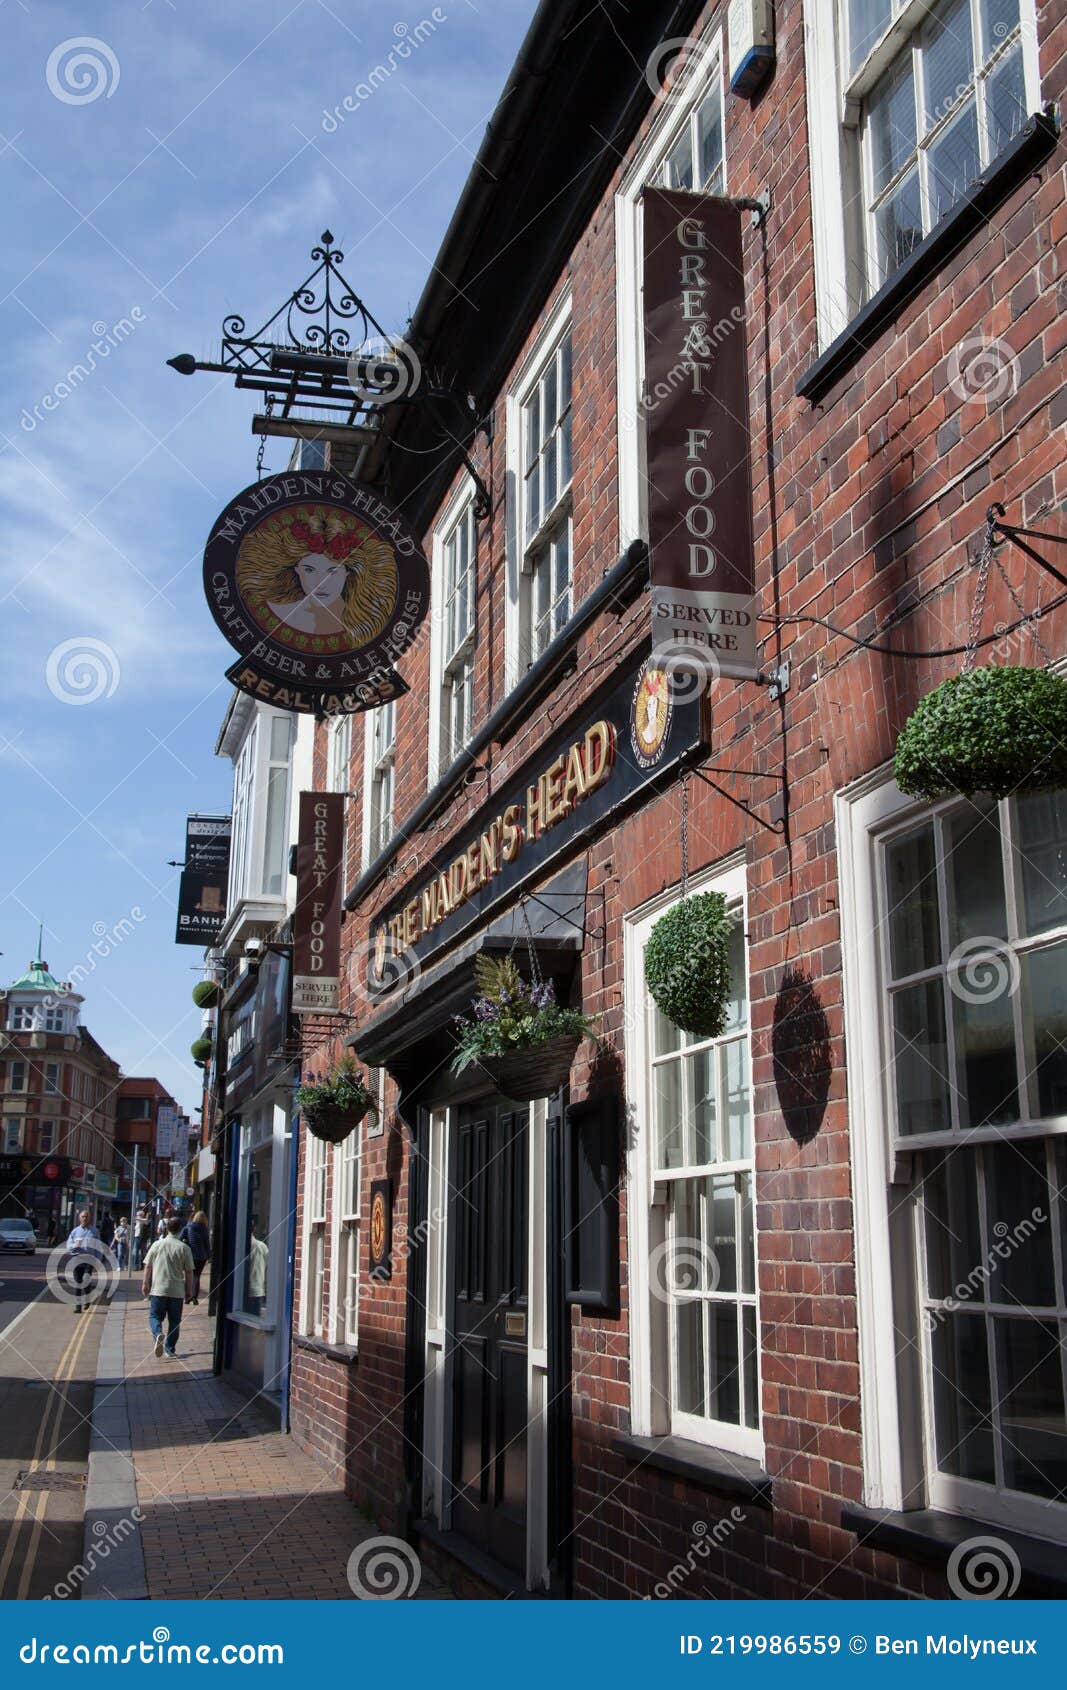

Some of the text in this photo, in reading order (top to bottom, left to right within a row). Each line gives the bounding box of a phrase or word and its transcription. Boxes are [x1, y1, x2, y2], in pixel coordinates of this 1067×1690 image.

[677, 217, 716, 578] GREAT FOOD
[218, 477, 416, 557] MAIDEN'S HEAD
[212, 572, 422, 679] CRAFT BEER & ALE HOUSE
[657, 602, 751, 651] SERVED HERE
[240, 668, 312, 710] REAL
[389, 720, 618, 957] THE MAIDEN'S HEAD
[310, 803, 329, 972] GREAT FOOD
[295, 982, 338, 1003] SERVED HERE
